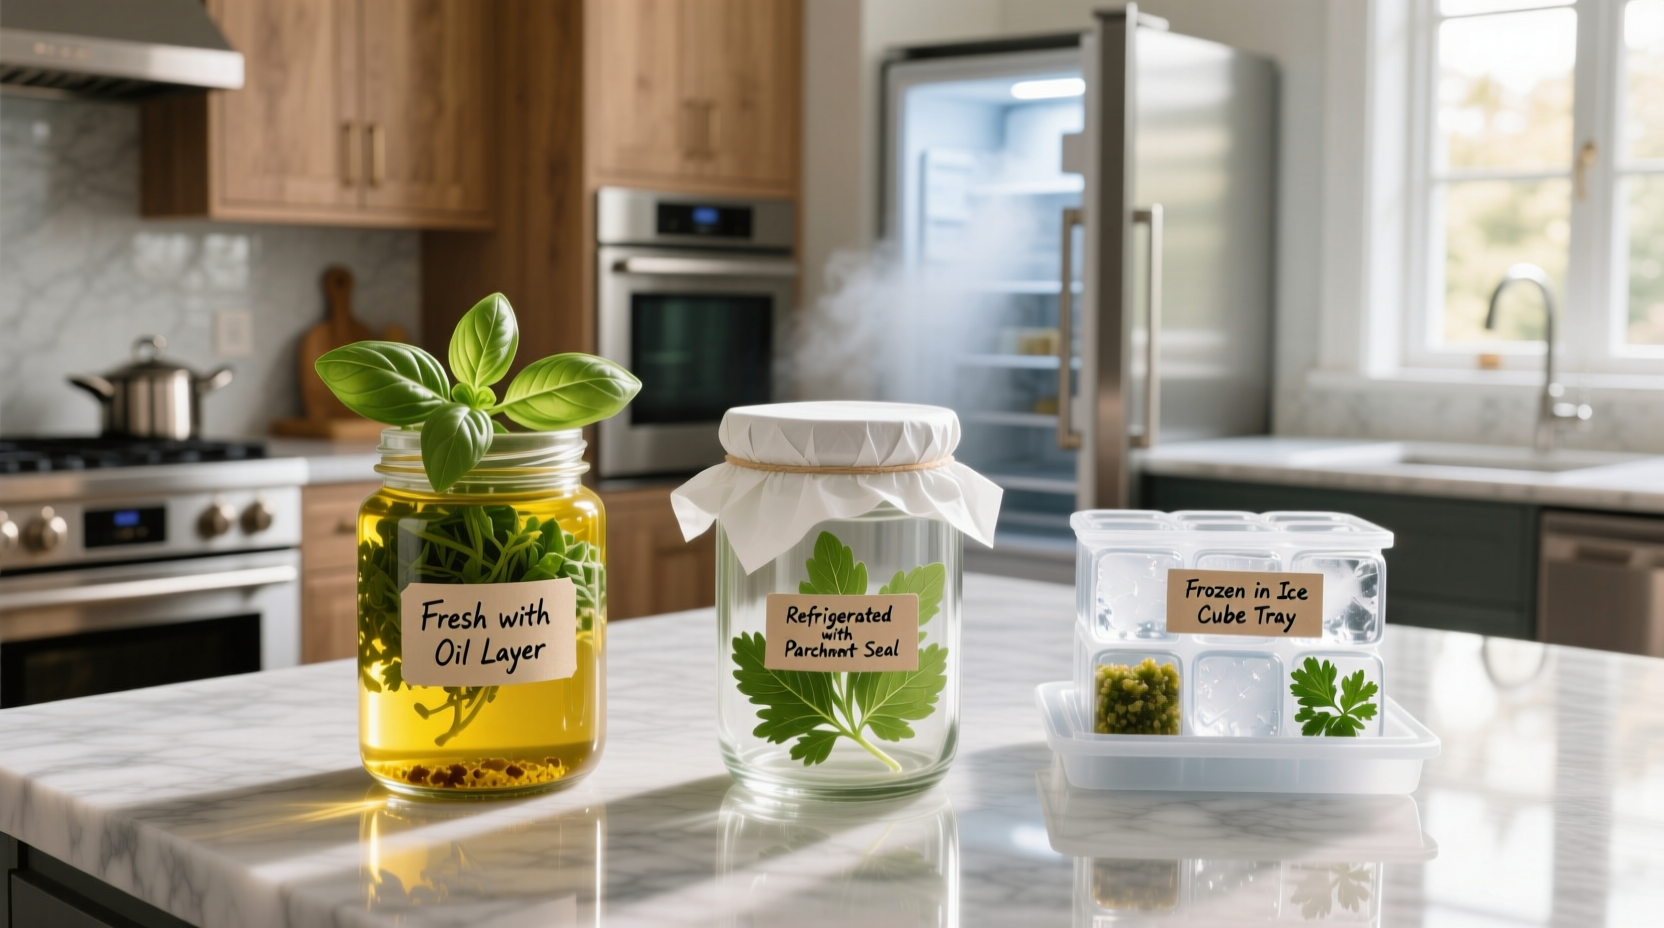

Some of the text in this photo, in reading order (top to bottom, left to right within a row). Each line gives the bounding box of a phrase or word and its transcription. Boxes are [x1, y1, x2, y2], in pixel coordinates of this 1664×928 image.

[1185, 578, 1309, 600] Frozen in Ice
[421, 598, 550, 631] Fresh with
[786, 605, 893, 630] Refrigerated
[1197, 604, 1297, 633] Cube Tray
[821, 626, 853, 641] with
[435, 637, 546, 674] Oil Layer
[863, 639, 900, 657] Seal
